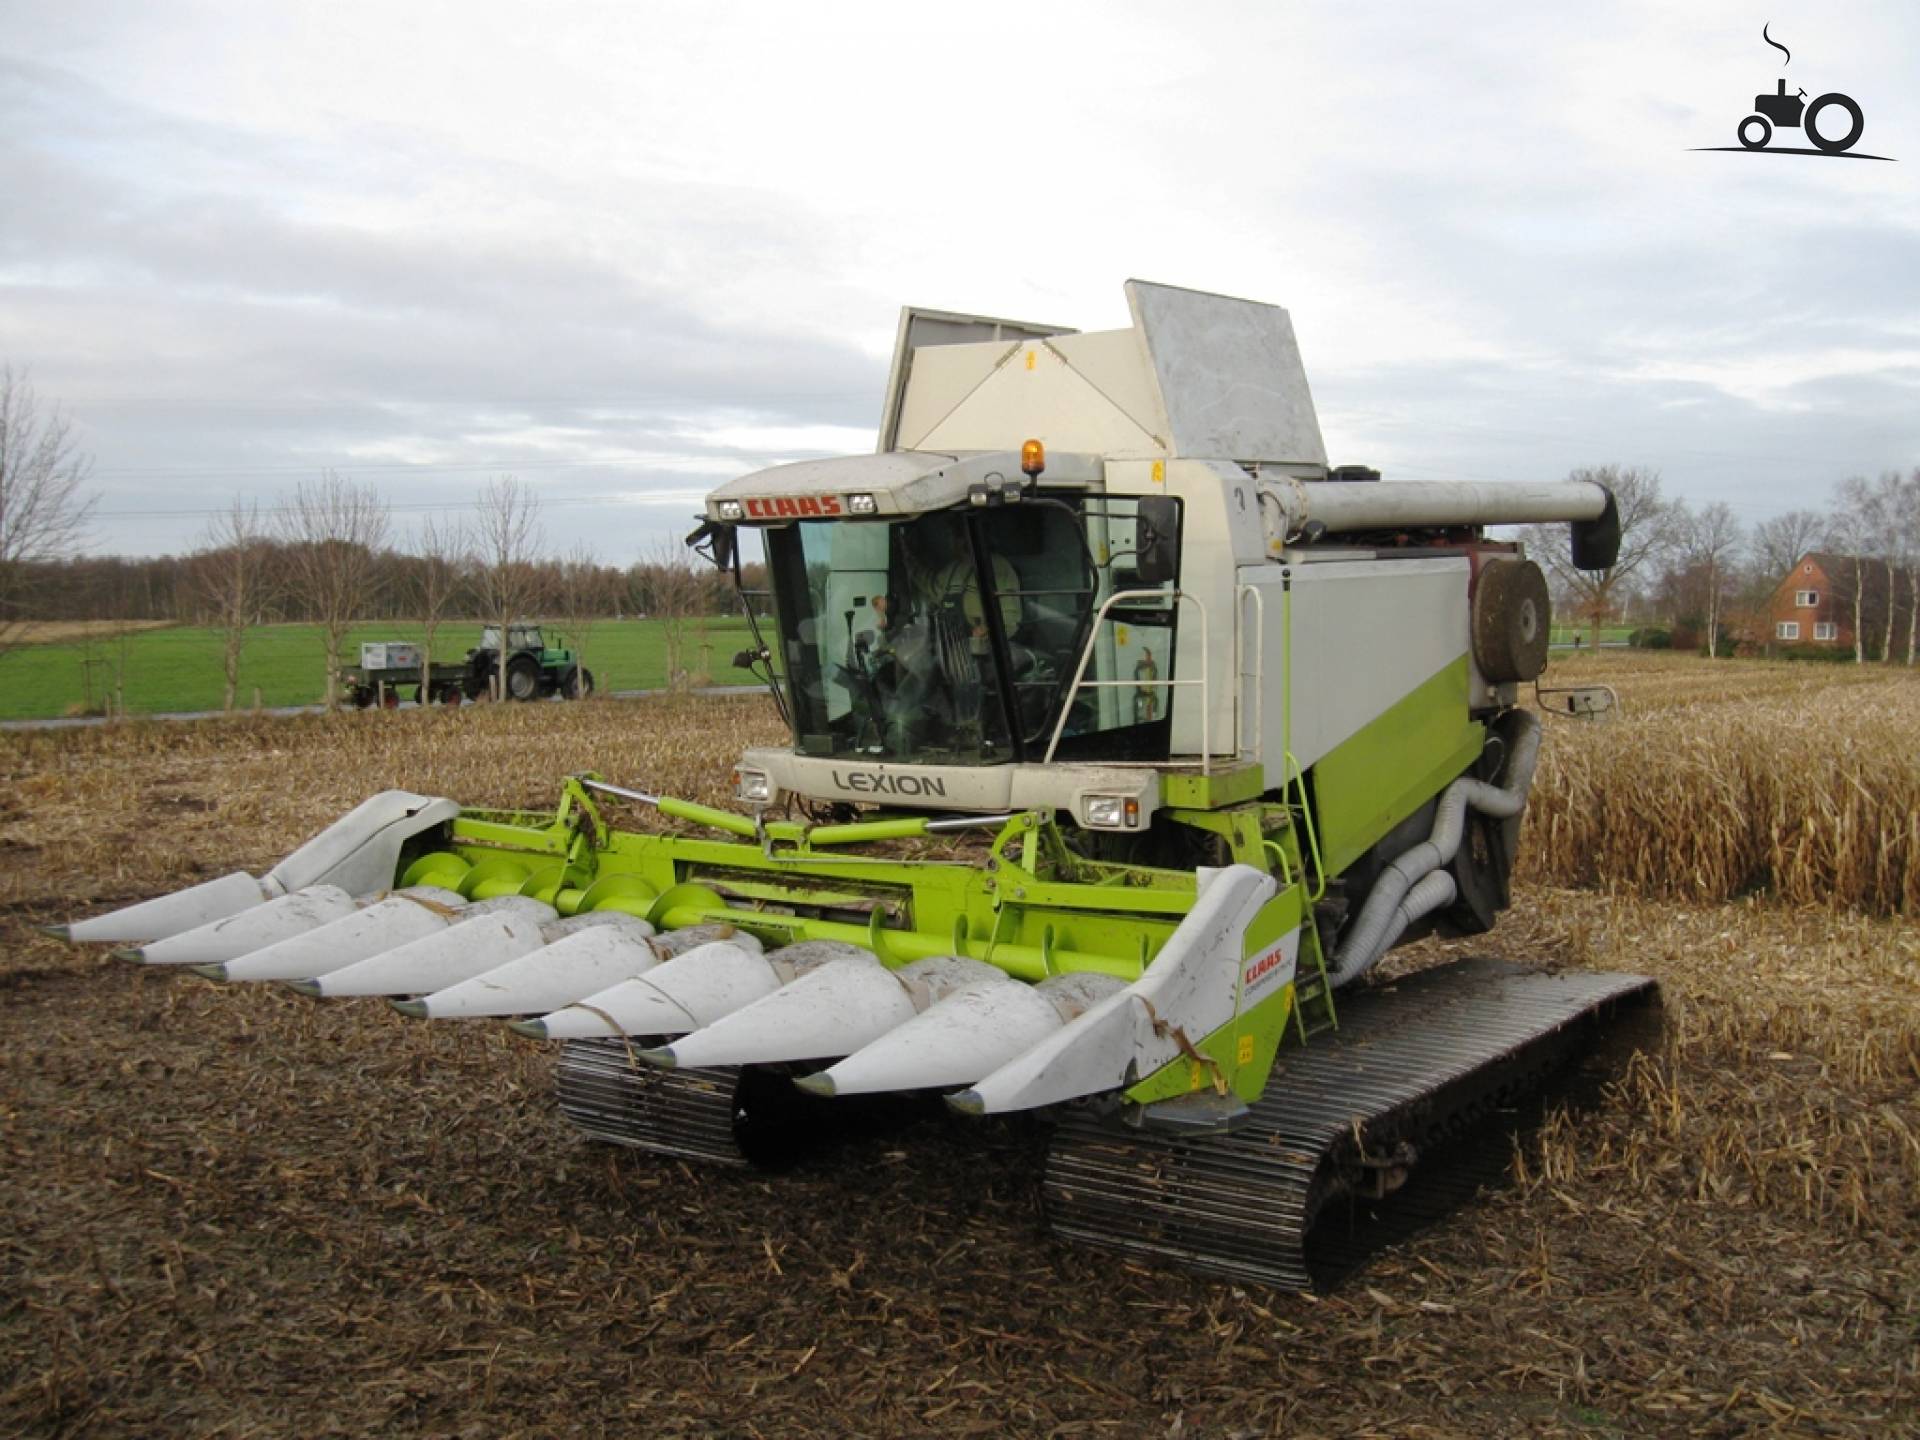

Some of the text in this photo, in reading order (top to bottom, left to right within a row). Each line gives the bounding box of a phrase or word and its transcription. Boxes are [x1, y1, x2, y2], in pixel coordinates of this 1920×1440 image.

[747, 496, 841, 518] CLAAS
[832, 770, 946, 796] LEXION
[1245, 948, 1282, 984] CLAAS
